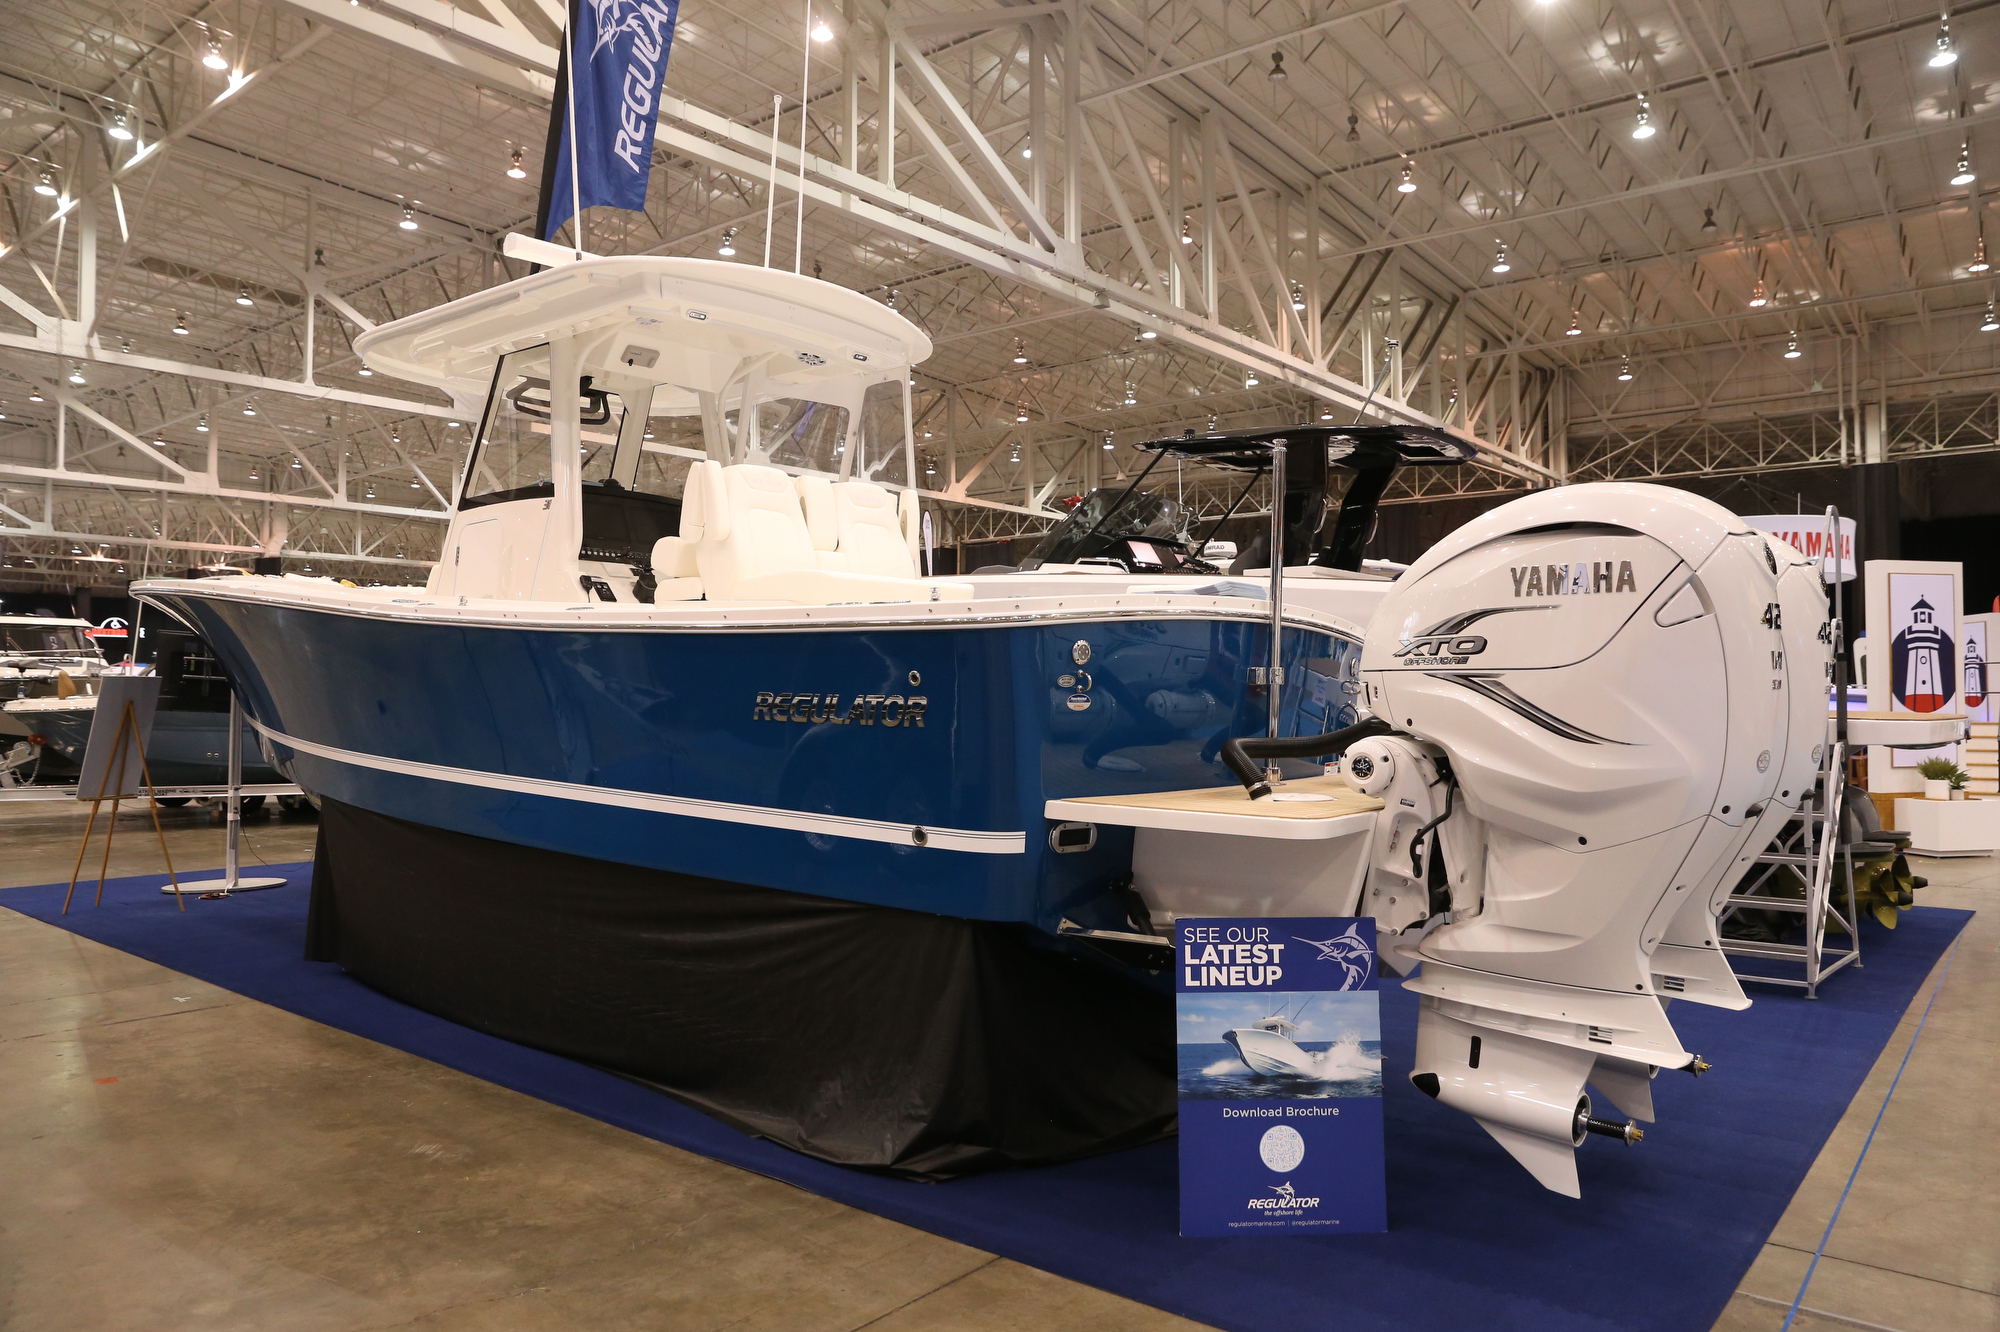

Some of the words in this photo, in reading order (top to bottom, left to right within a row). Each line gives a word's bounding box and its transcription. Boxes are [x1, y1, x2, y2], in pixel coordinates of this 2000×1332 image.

[1510, 560, 1637, 597] YAMAHA
[1392, 635, 1488, 658] XTO
[1403, 656, 1470, 666] OFFSHORE
[753, 691, 928, 728] REGULATOR
[1184, 927, 1220, 943] SEE
[1227, 927, 1270, 943] OUR
[1184, 943, 1285, 965] LATEST
[1185, 965, 1283, 987] LINEUP
[1222, 1106, 1283, 1118] Download
[1286, 1105, 1340, 1117] Brochure
[1247, 1197, 1320, 1209] REGULATOR
[1228, 1220, 1285, 1228] regulatormarine.com
